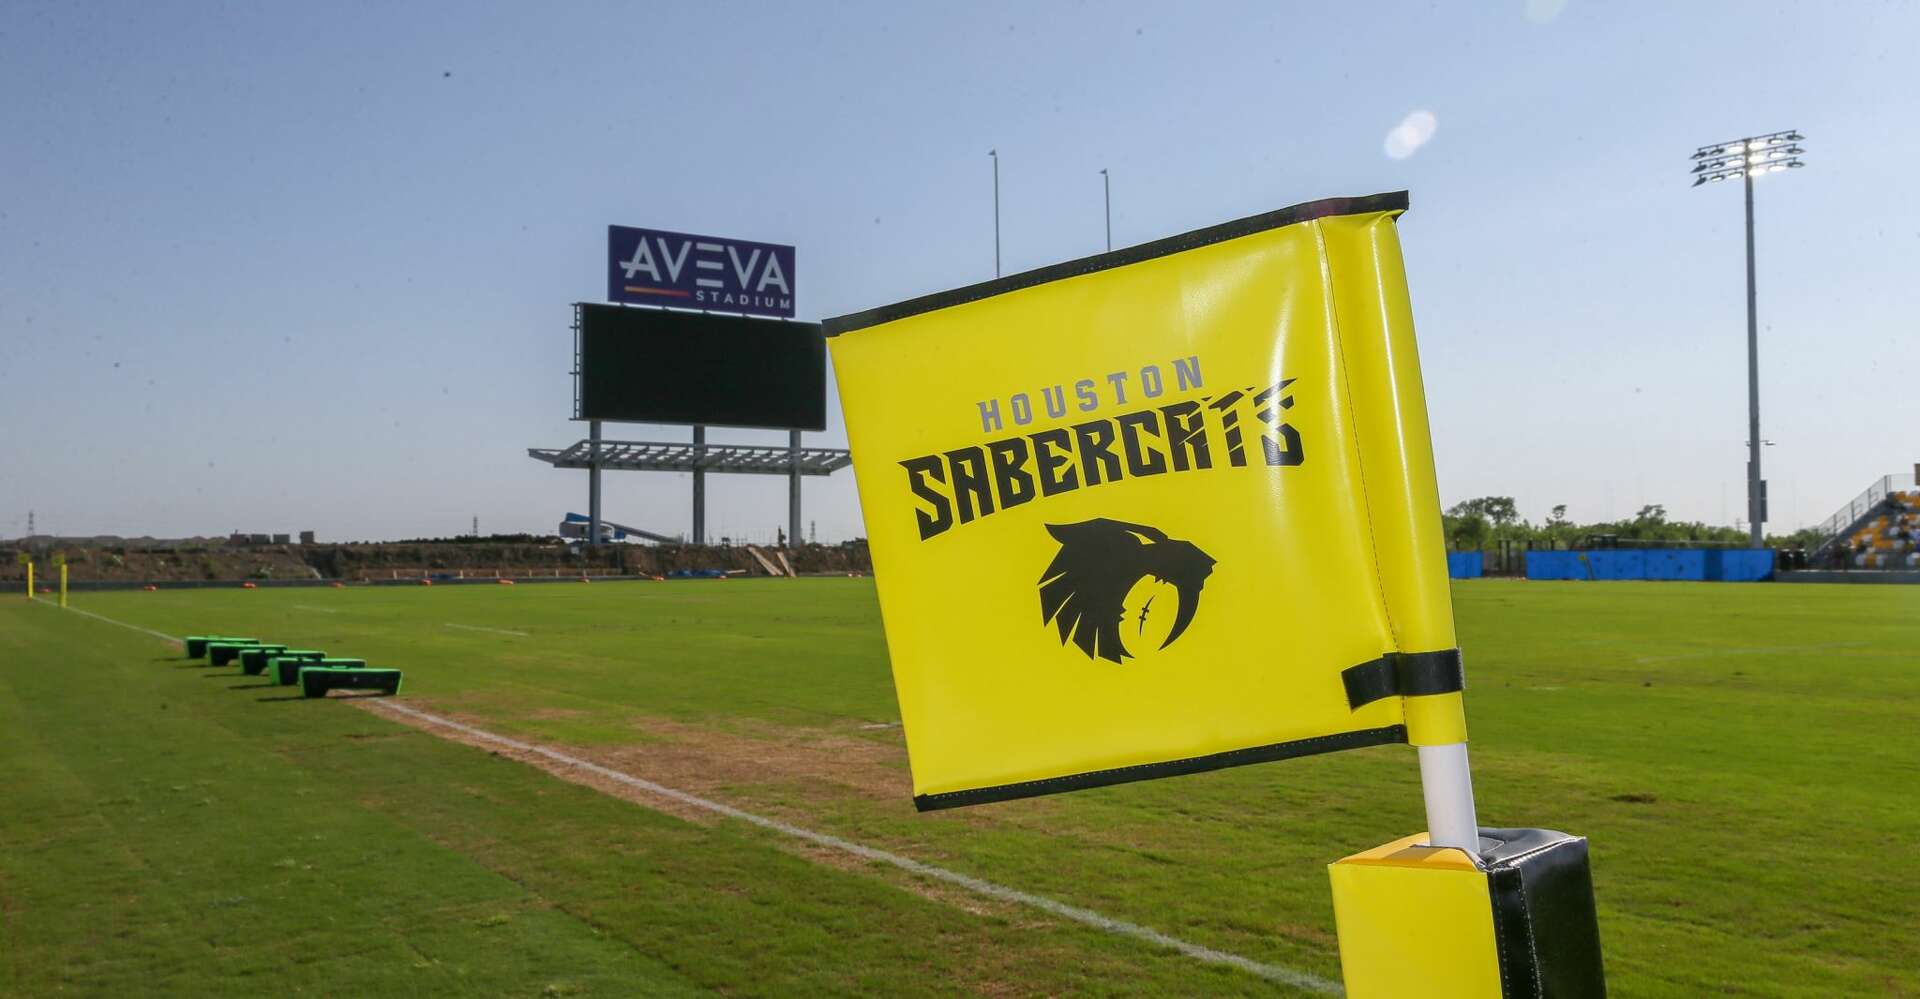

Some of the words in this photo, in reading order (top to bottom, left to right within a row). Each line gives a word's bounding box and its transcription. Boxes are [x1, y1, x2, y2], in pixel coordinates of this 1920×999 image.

[619, 235, 789, 294] AVEVA
[696, 290, 791, 309] STADIUM
[976, 355, 1205, 433] HOUSTON
[897, 377, 1305, 541] SABERCATS
